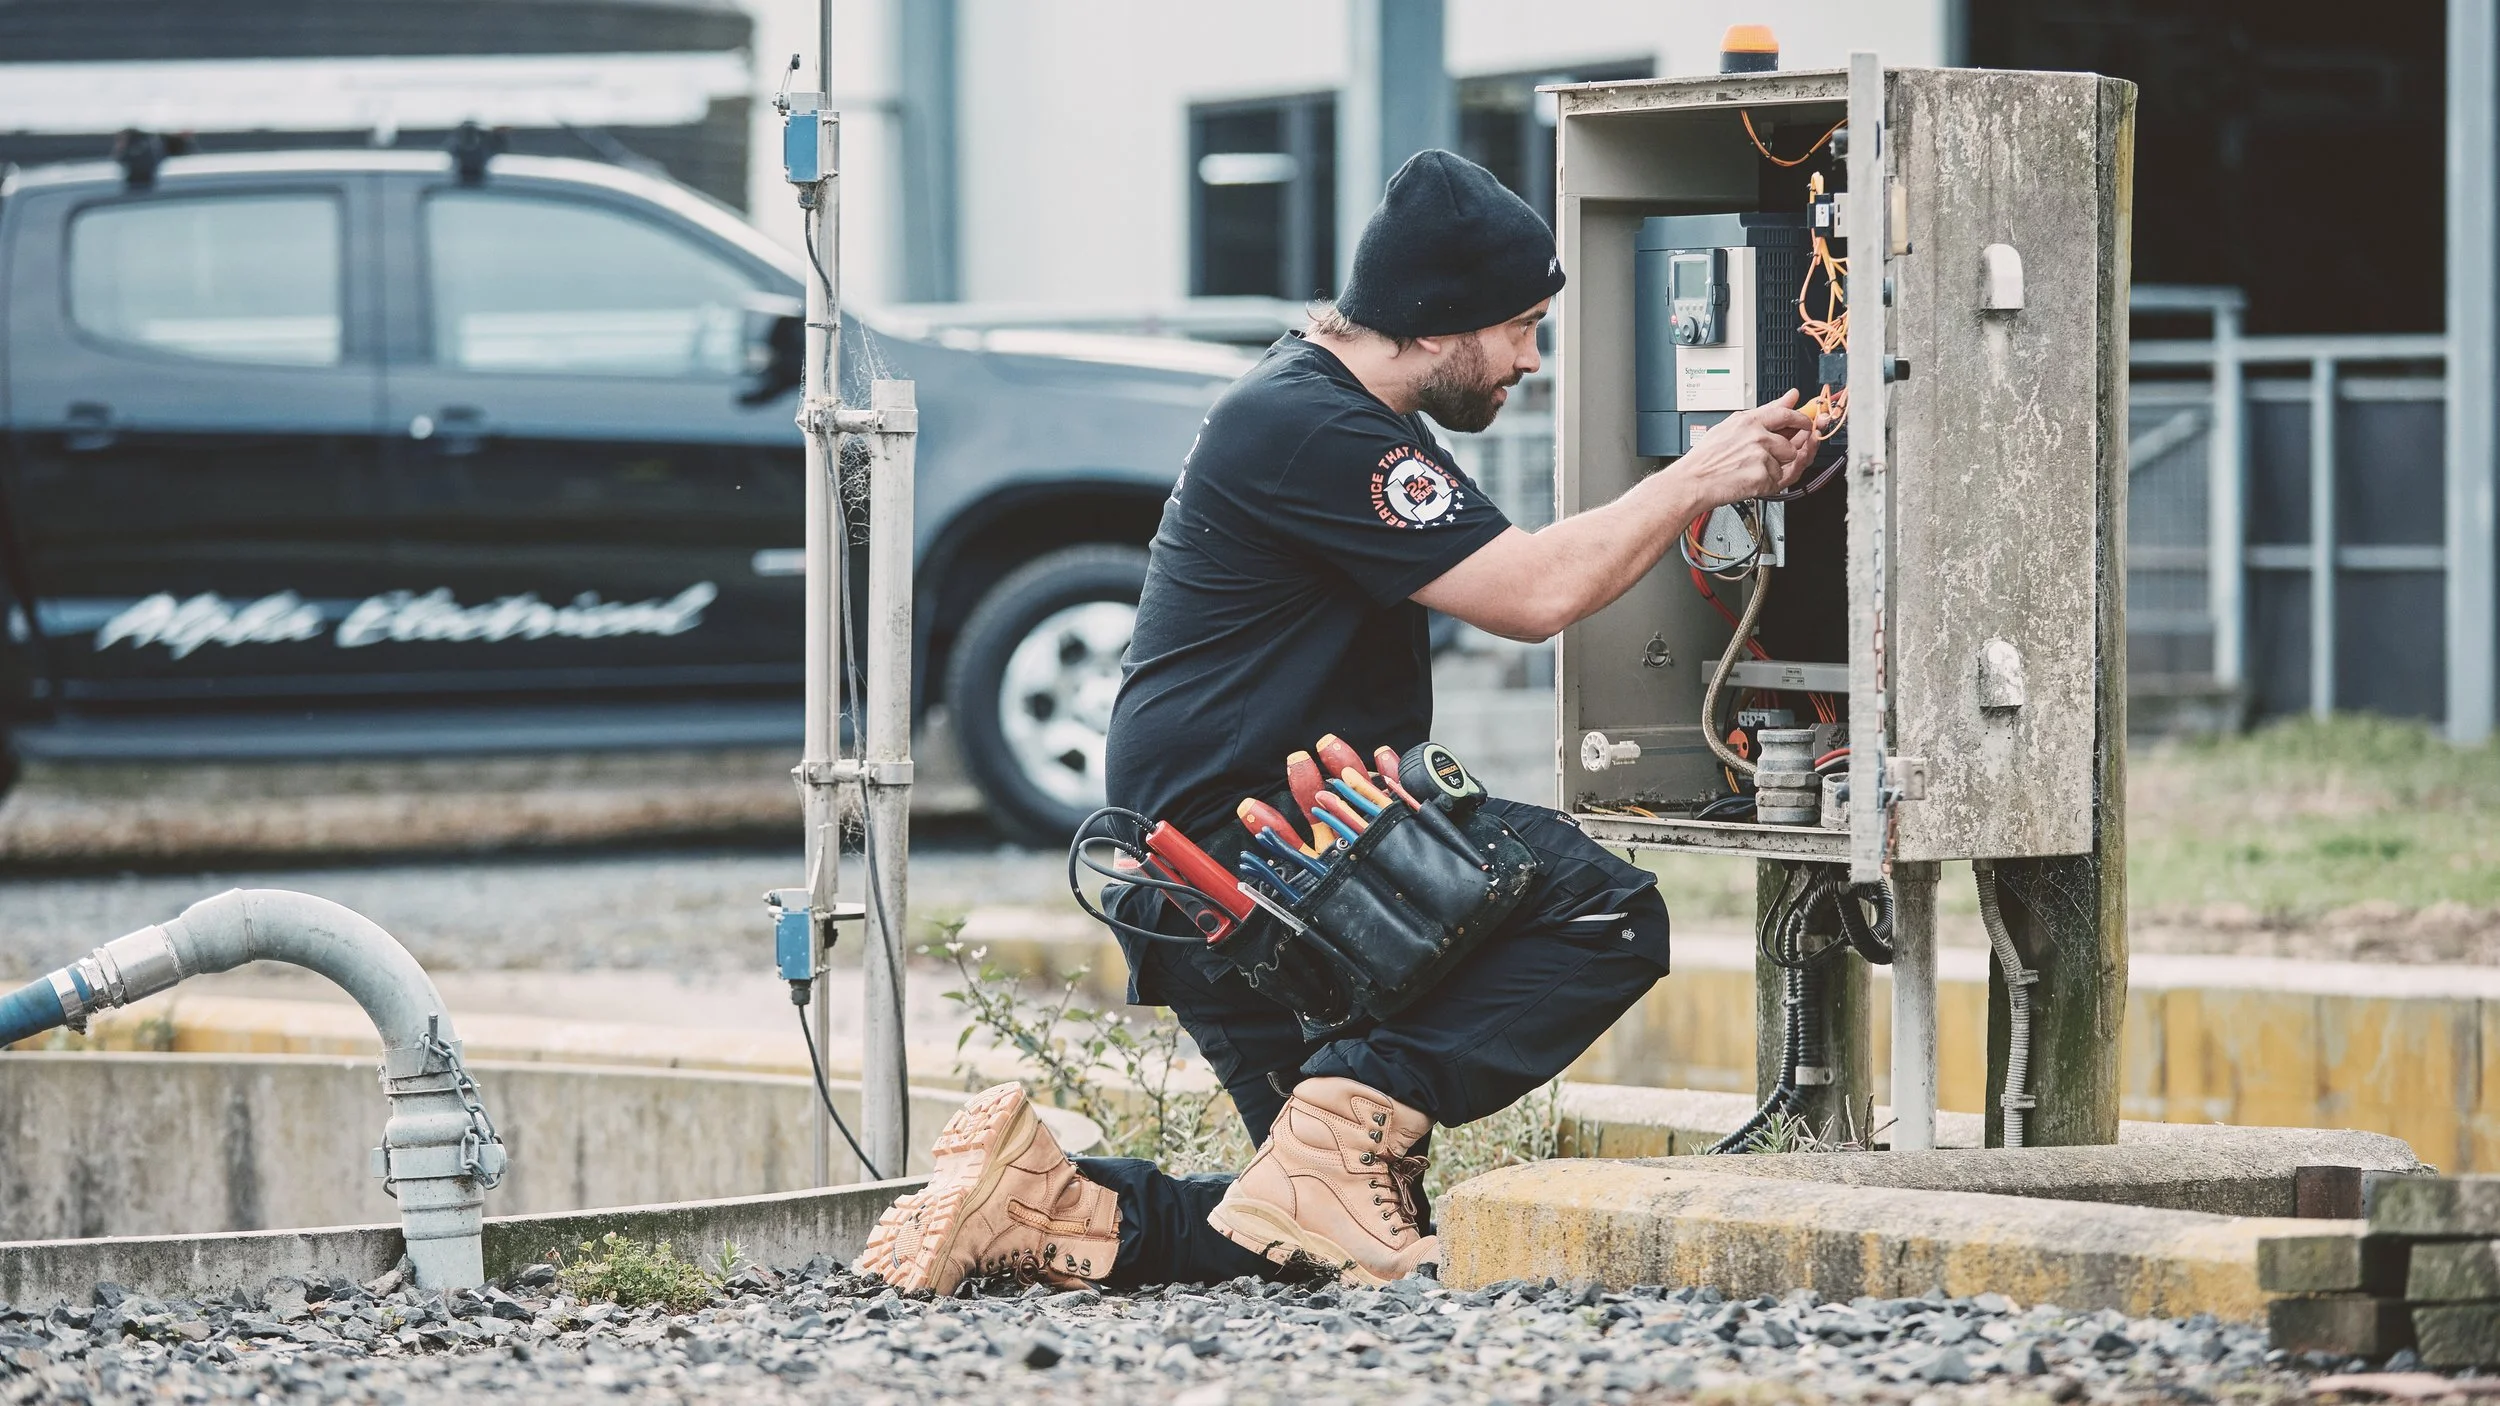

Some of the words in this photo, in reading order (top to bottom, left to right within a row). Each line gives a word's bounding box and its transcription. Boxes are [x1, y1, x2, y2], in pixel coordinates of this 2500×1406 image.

[1378, 446, 1409, 470] THAT
[1406, 476, 1429, 498] 24
[1414, 485, 1433, 503] HOUR
[1371, 473, 1407, 528] SERVICE
[335, 581, 717, 647] Electrical
